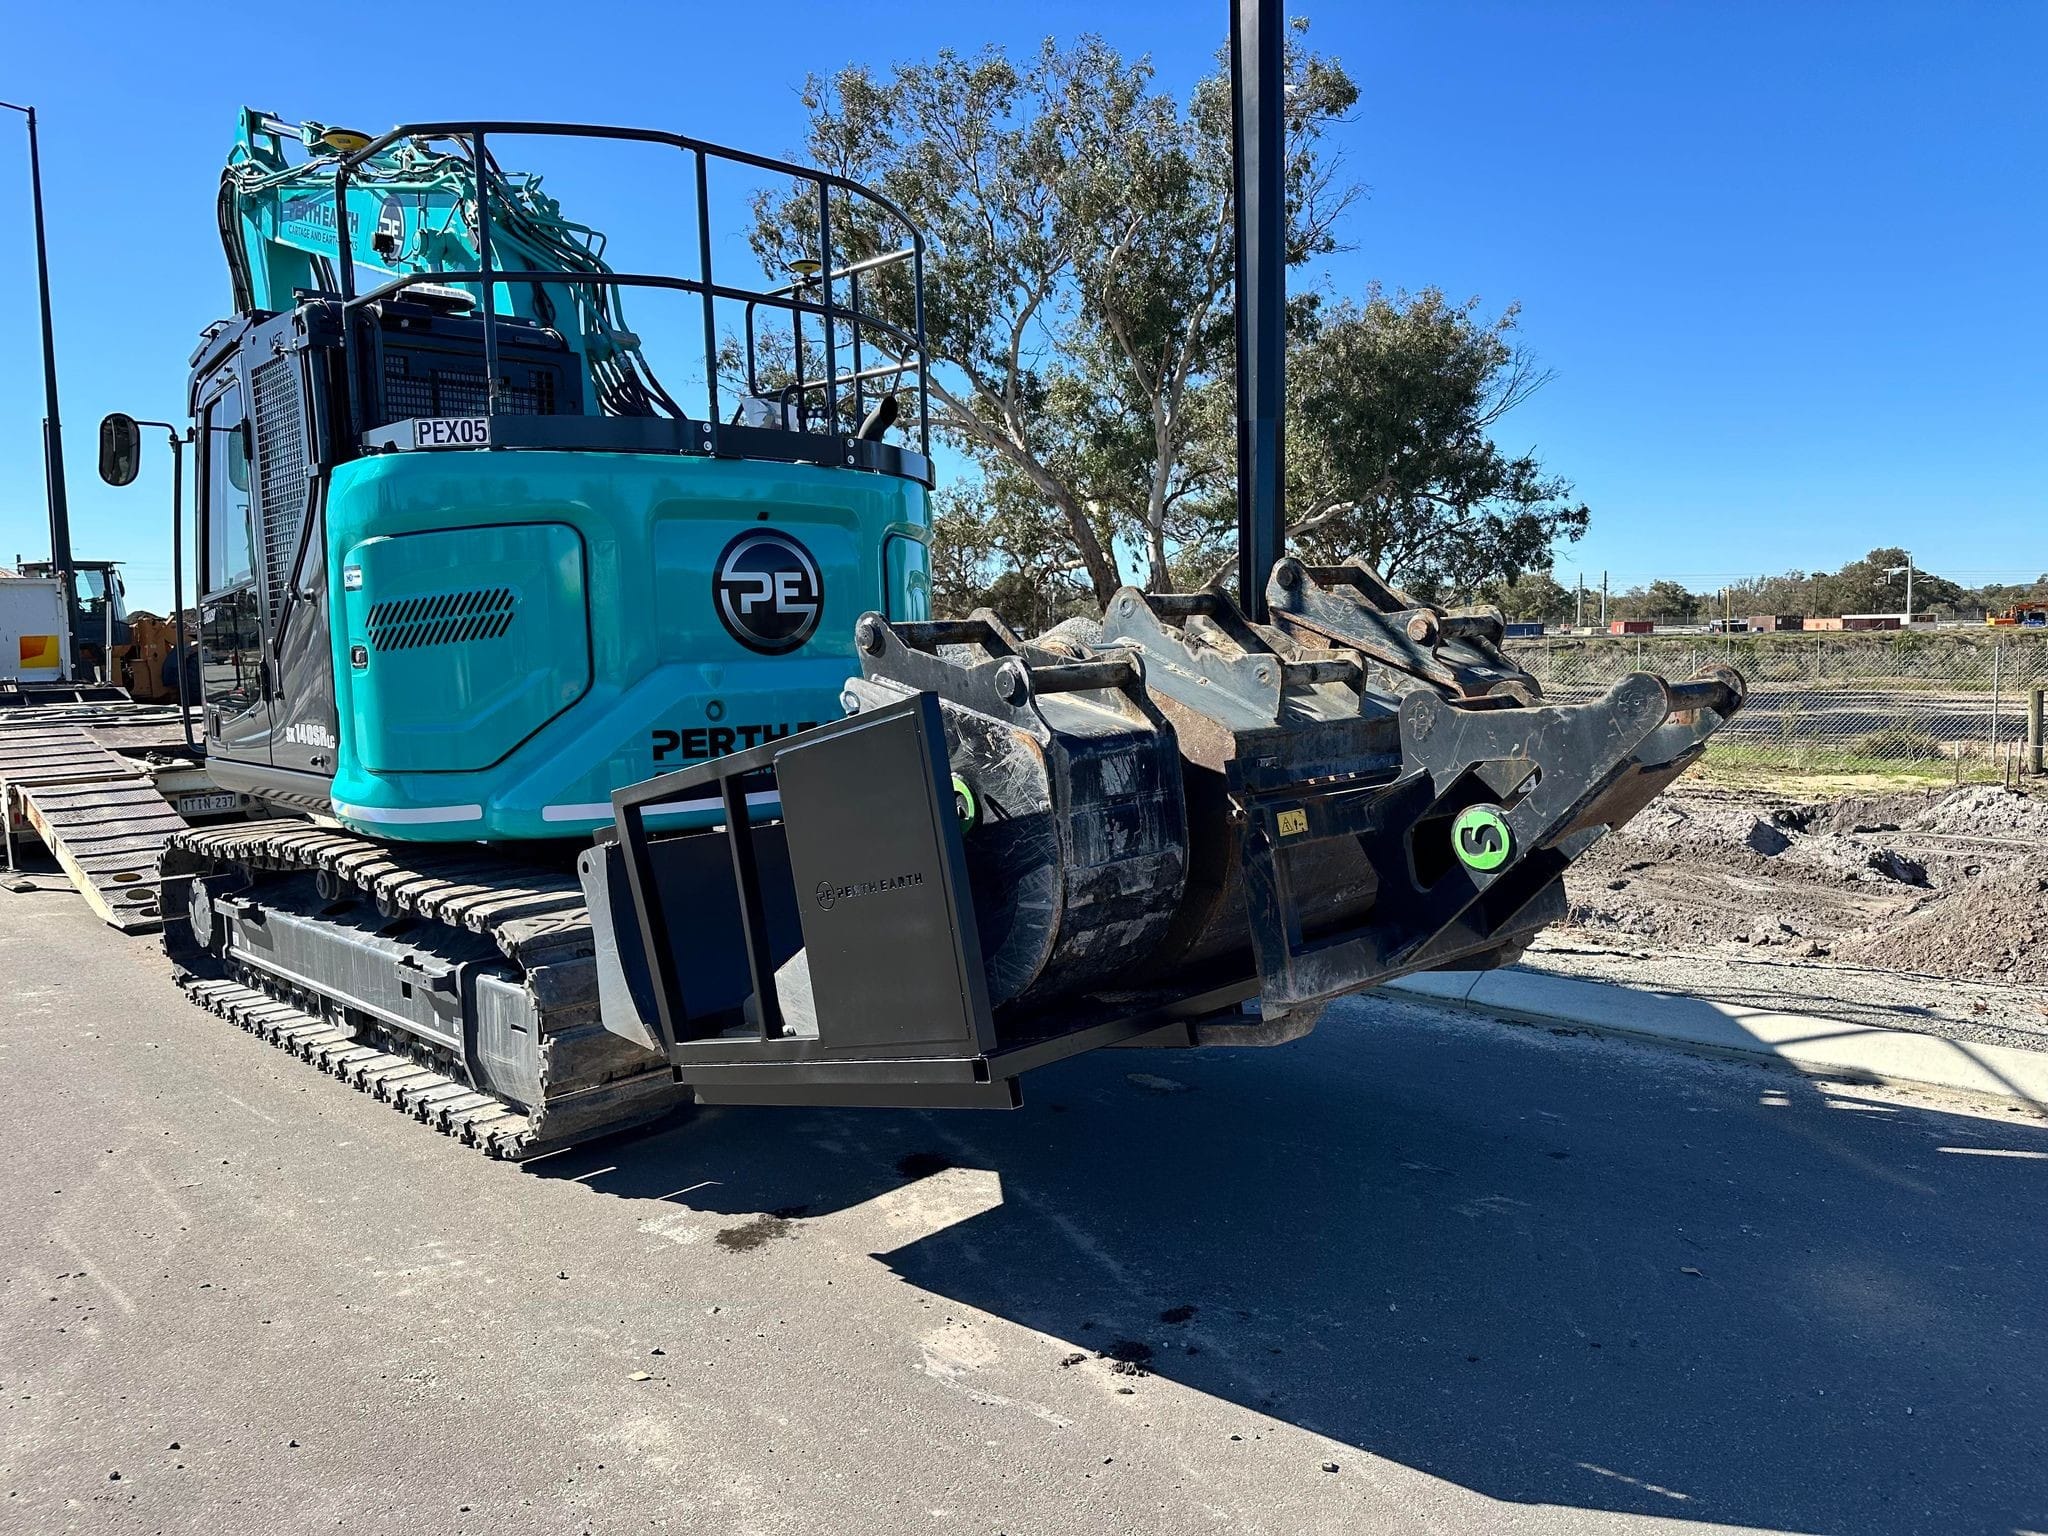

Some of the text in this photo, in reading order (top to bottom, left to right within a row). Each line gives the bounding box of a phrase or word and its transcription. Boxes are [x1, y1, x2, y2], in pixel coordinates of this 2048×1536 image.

[323, 206, 359, 234] EAH
[288, 224, 358, 252] CARTAGE AND EARTHKS
[418, 419, 487, 445] PEX05
[837, 882, 878, 899] PERTH
[880, 873, 923, 892] EARTH
